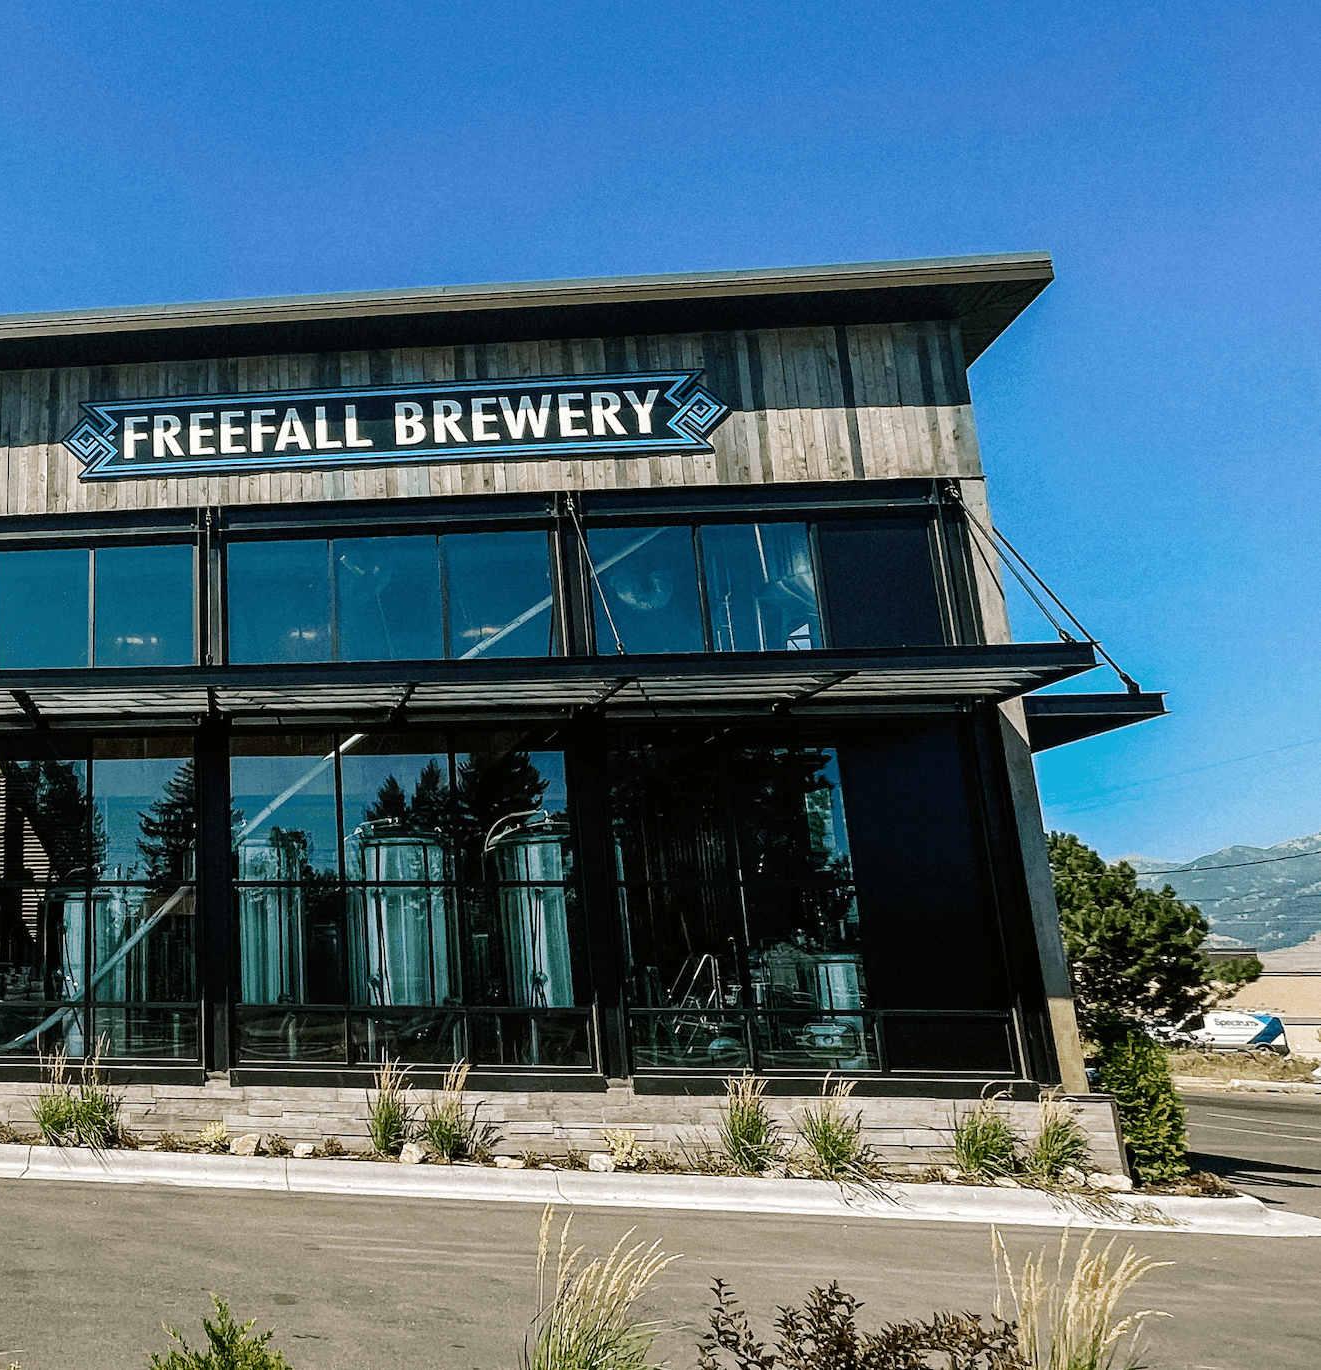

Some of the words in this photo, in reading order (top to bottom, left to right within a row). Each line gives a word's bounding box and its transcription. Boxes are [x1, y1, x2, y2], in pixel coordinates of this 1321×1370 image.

[123, 404, 373, 459] FREEFALL
[394, 389, 659, 445] BREWERY
[1214, 1018, 1259, 1026] Spectrum
